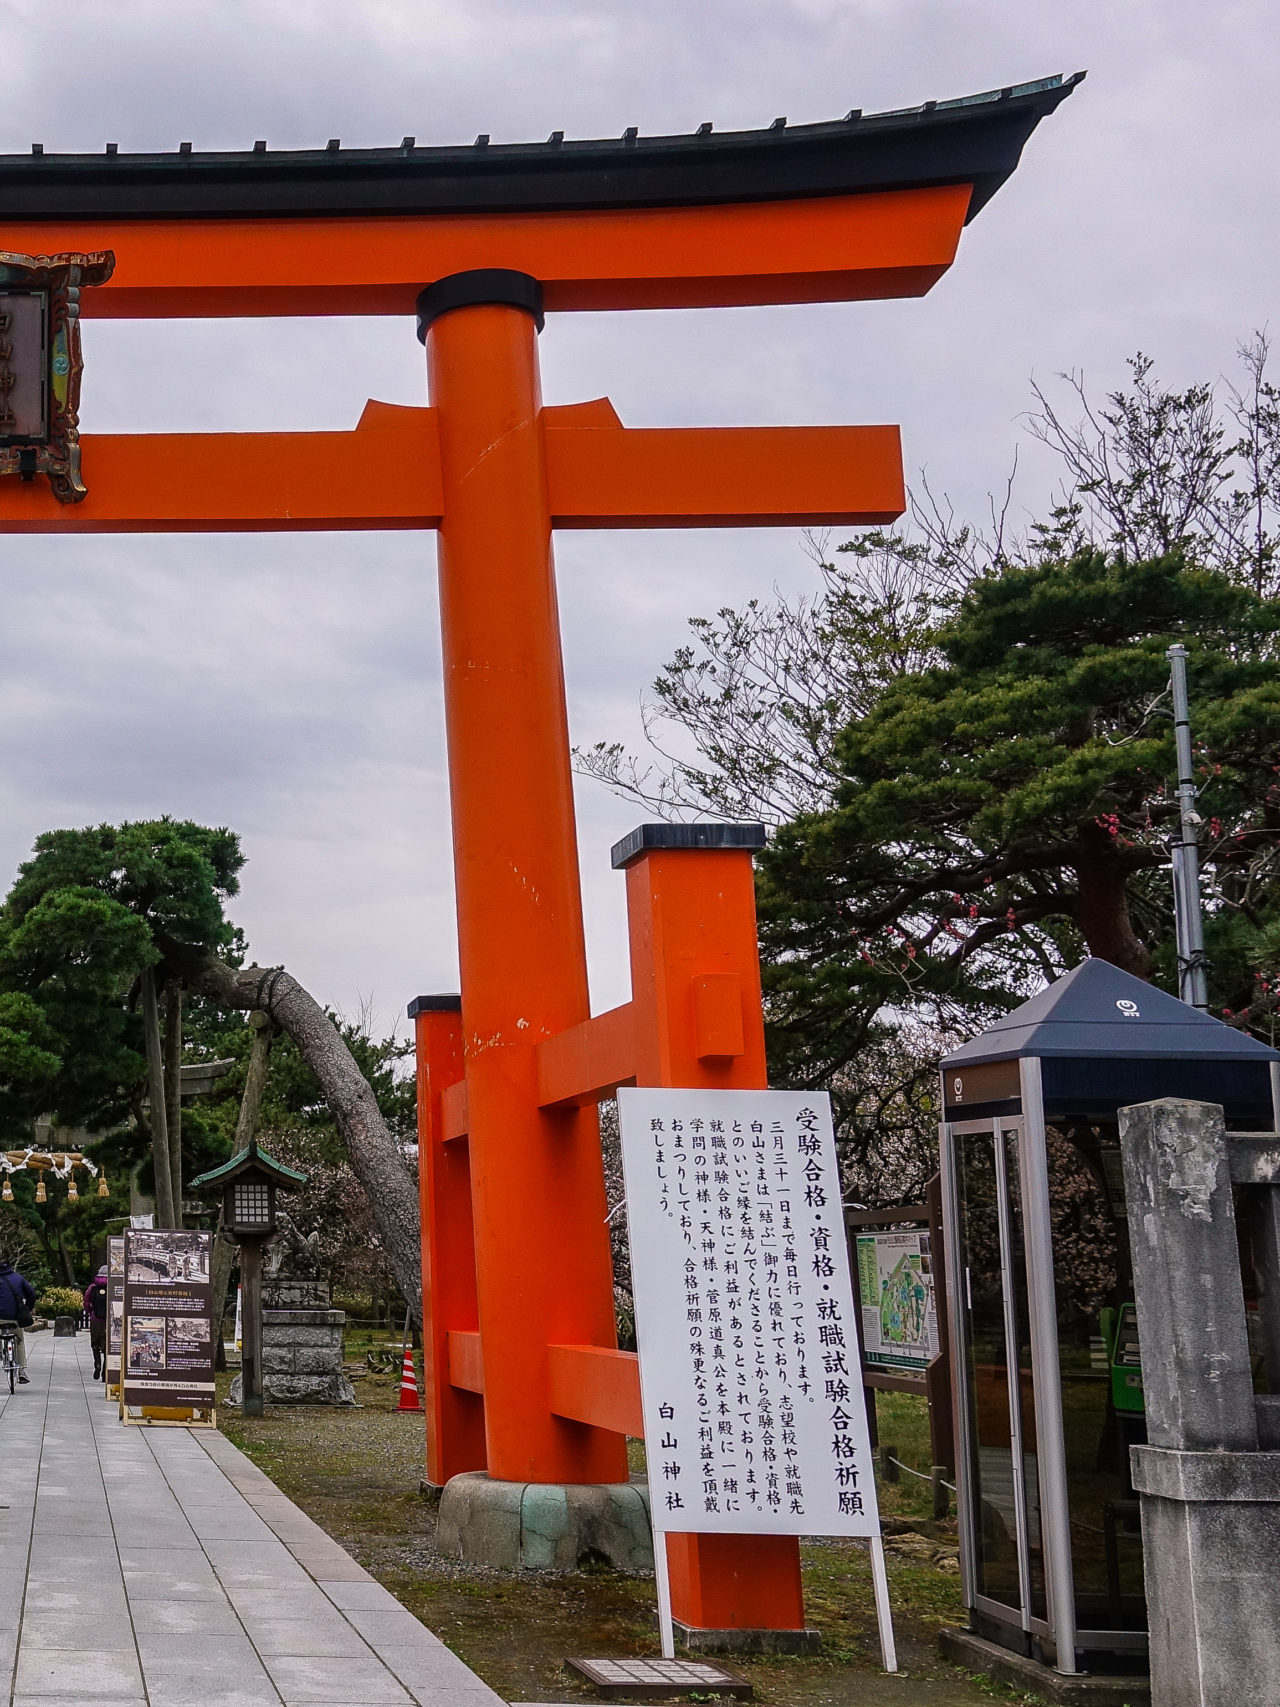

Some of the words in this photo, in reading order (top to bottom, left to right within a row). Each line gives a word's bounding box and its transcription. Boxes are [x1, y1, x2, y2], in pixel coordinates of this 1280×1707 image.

[650, 1118, 674, 1218] 致しましょう。
[671, 1119, 721, 1513] おまつりしており、合格祈願の殊更なるご利益を頂戴
[689, 1118, 740, 1512] 学問の神様・天神様・菅原道真公を本殿に一緒に
[709, 1119, 763, 1512] 就職試験合格にご利益があるとされております。
[750, 1120, 805, 1515] 白山さまは「結ぶ」御力に優れており、志望校や就職先
[769, 1121, 814, 1403] 三月三十一日まで毎日行っております。
[795, 1107, 865, 1516] 受験合格・資格・就職試験合格祈願
[658, 1402, 685, 1511] 白山神社
